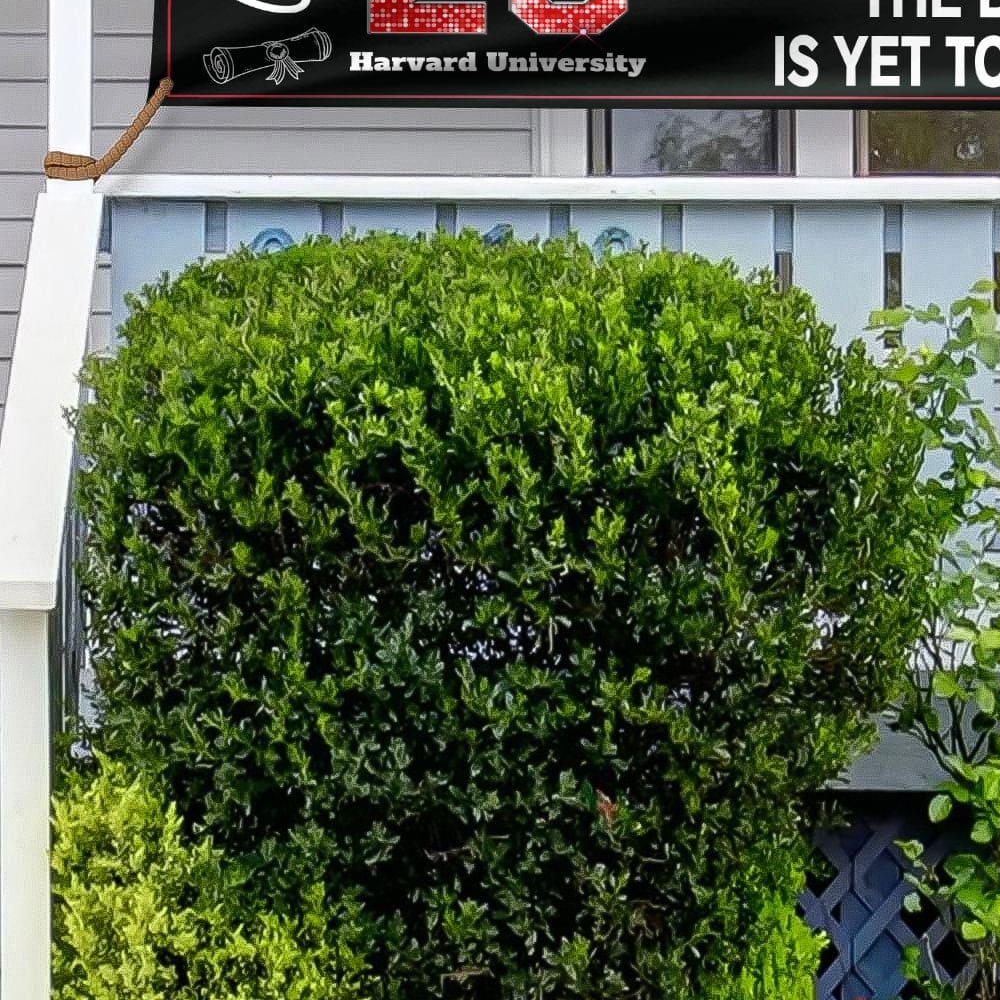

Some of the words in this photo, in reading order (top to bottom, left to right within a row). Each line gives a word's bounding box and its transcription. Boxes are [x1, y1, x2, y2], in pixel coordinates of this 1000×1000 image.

[349, 51, 477, 73] Harvard
[485, 51, 647, 78] University
[774, 34, 820, 88] IS
[833, 35, 931, 88] YET
